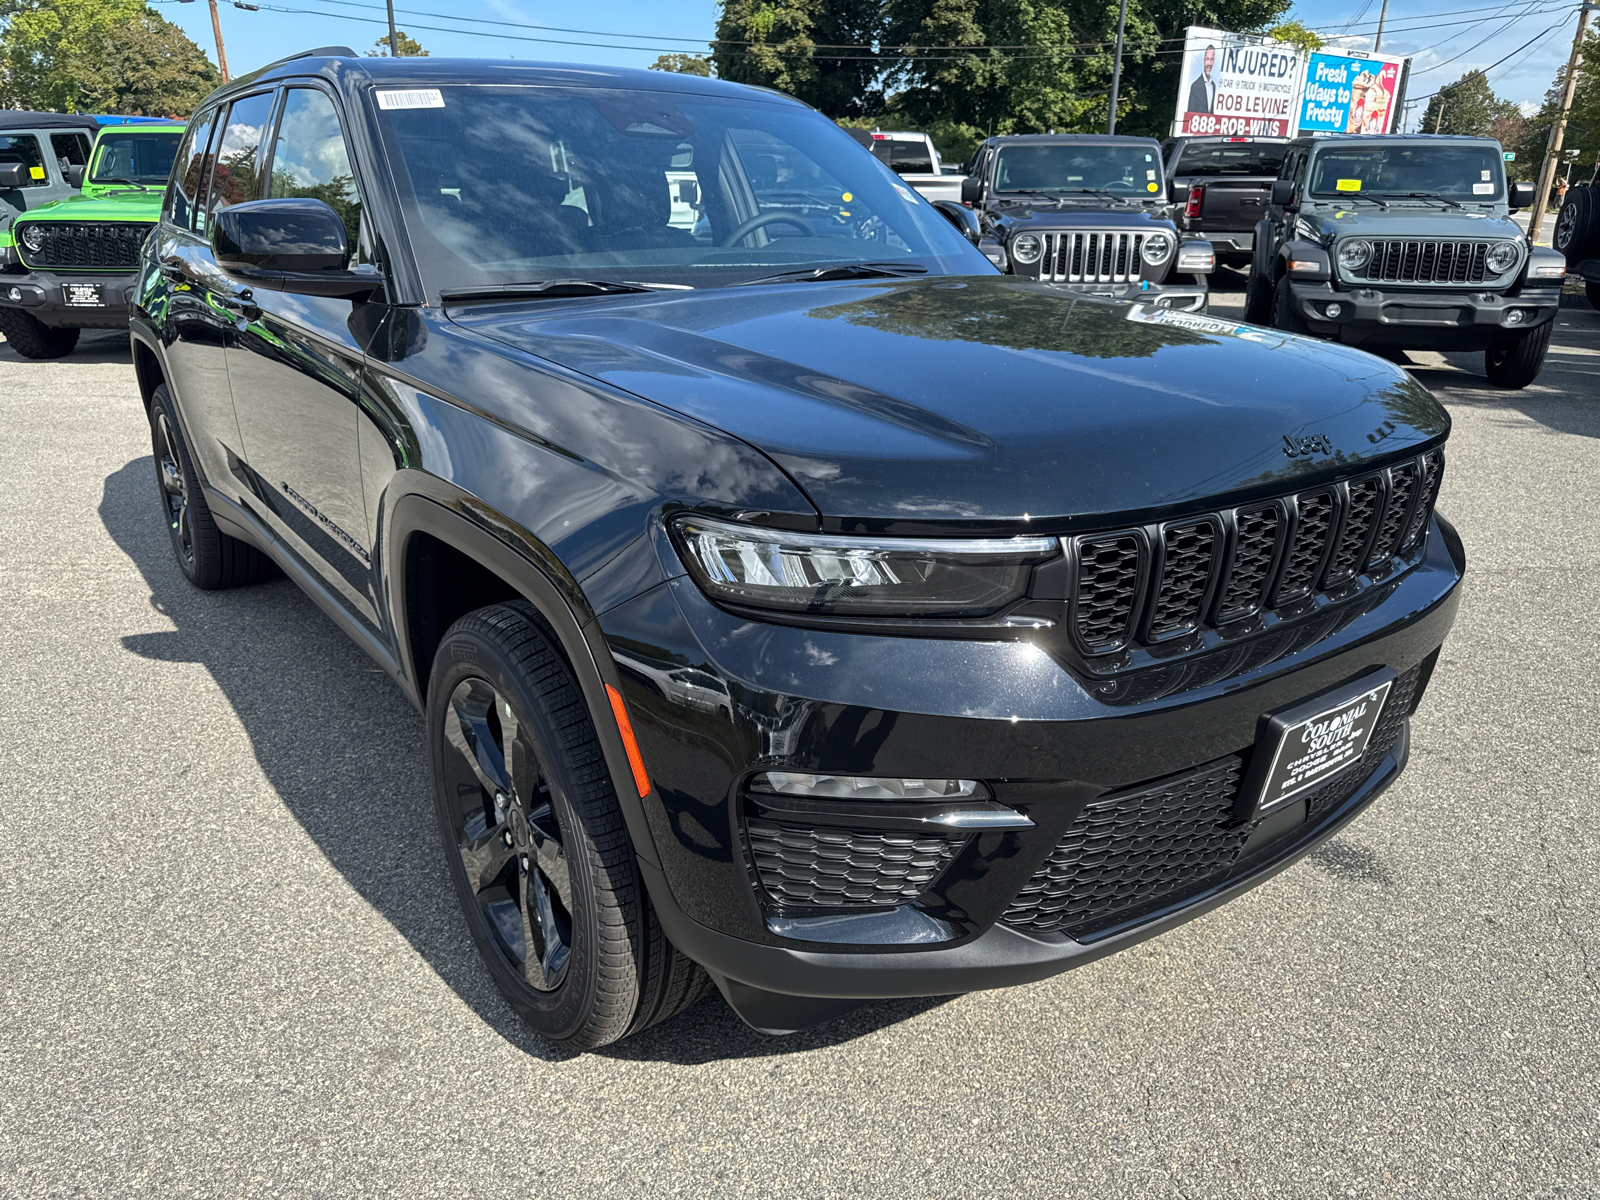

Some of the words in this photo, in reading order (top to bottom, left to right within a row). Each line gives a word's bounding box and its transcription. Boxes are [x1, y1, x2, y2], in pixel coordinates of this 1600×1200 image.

[1220, 48, 1297, 79] INJURED?
[1315, 62, 1348, 84] Fresh
[1223, 79, 1234, 88] CAR
[1240, 80, 1256, 90] TRUCK
[1305, 81, 1337, 107] Ways
[1337, 86, 1350, 104] to
[1216, 93, 1243, 111] ROB
[1245, 95, 1289, 115] LEVINE
[1305, 102, 1344, 128] Frosty
[1190, 115, 1280, 137] 888-ROB-WINS
[1282, 433, 1333, 458] Jeep
[450, 643, 480, 665] PIRELLI
[1301, 702, 1367, 743] COLONIAL
[1307, 721, 1354, 754] SOUTH
[1286, 740, 1343, 770] CHRYSLER
[1290, 754, 1328, 776] DODGE
